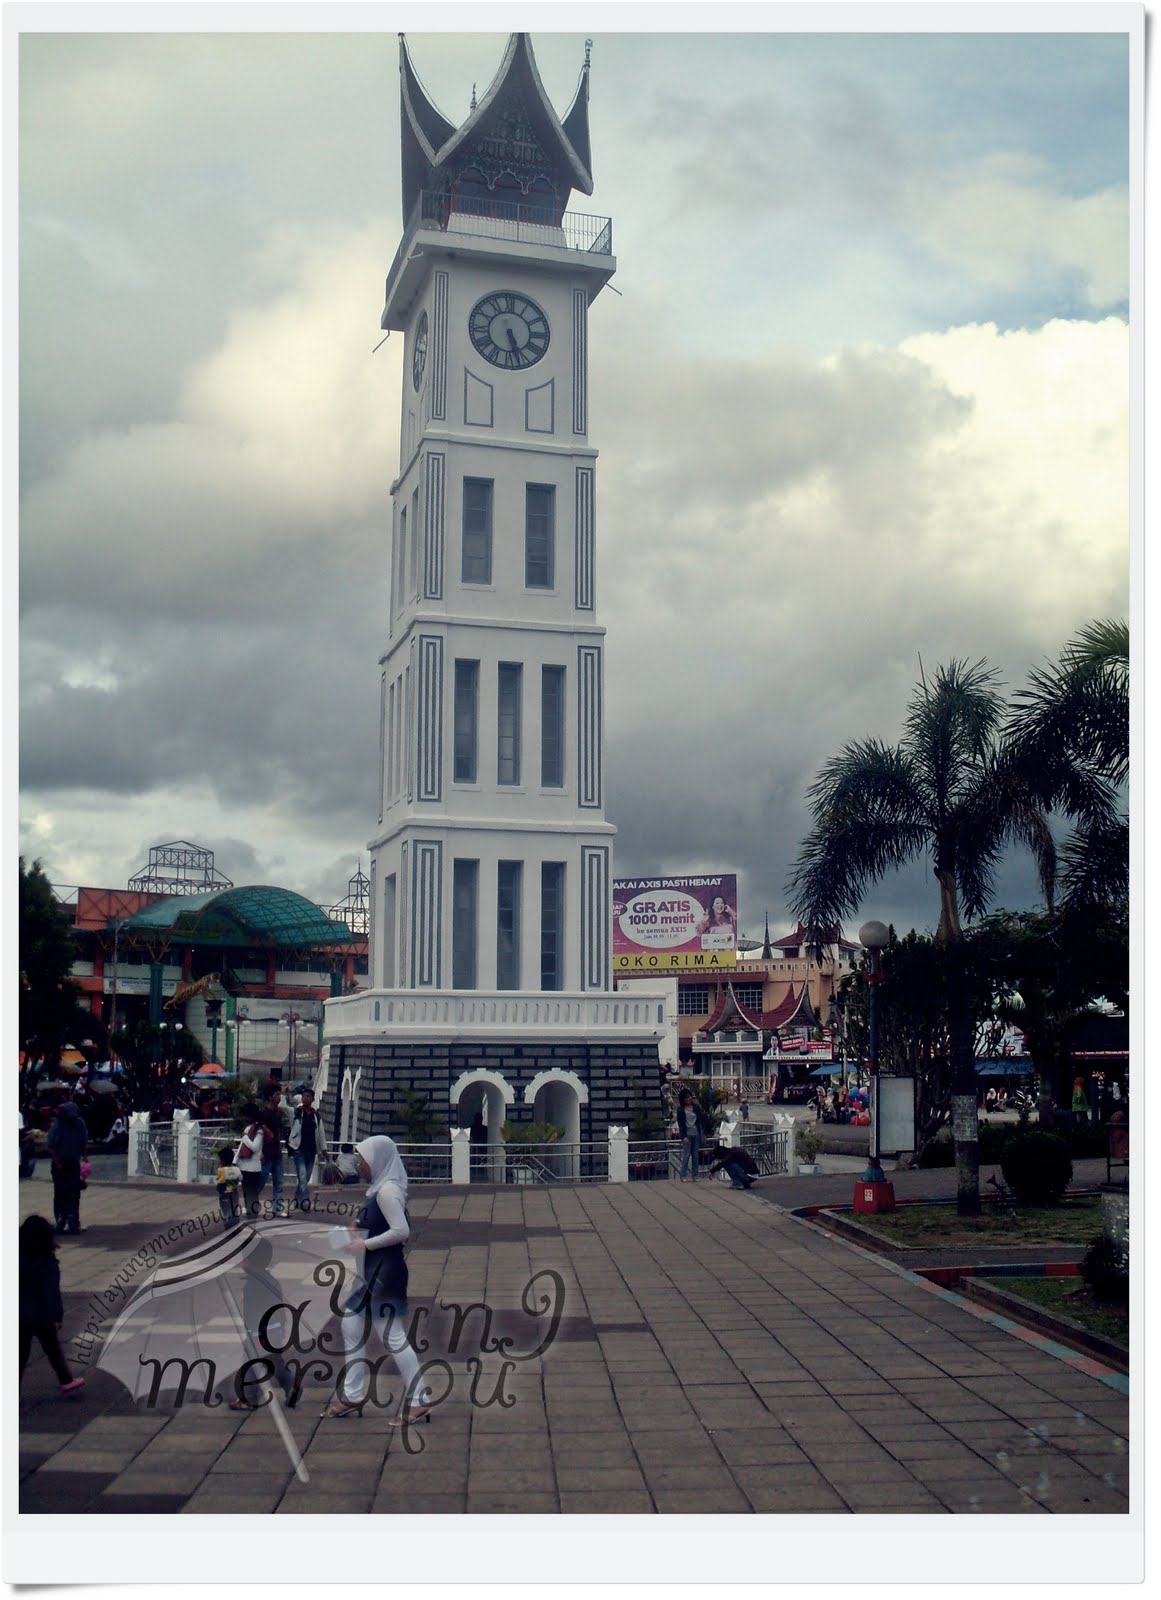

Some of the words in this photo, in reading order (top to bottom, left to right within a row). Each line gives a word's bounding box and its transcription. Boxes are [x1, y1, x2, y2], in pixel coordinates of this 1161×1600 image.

[613, 881, 637, 889] AKAI
[662, 879, 688, 888] PASTI
[689, 878, 722, 886] HEMAT
[633, 901, 690, 913] GRATIS
[628, 914, 658, 925] 1000
[660, 913, 695, 924] menit
[613, 956, 658, 967] OKO
[670, 954, 719, 966] RIMA
